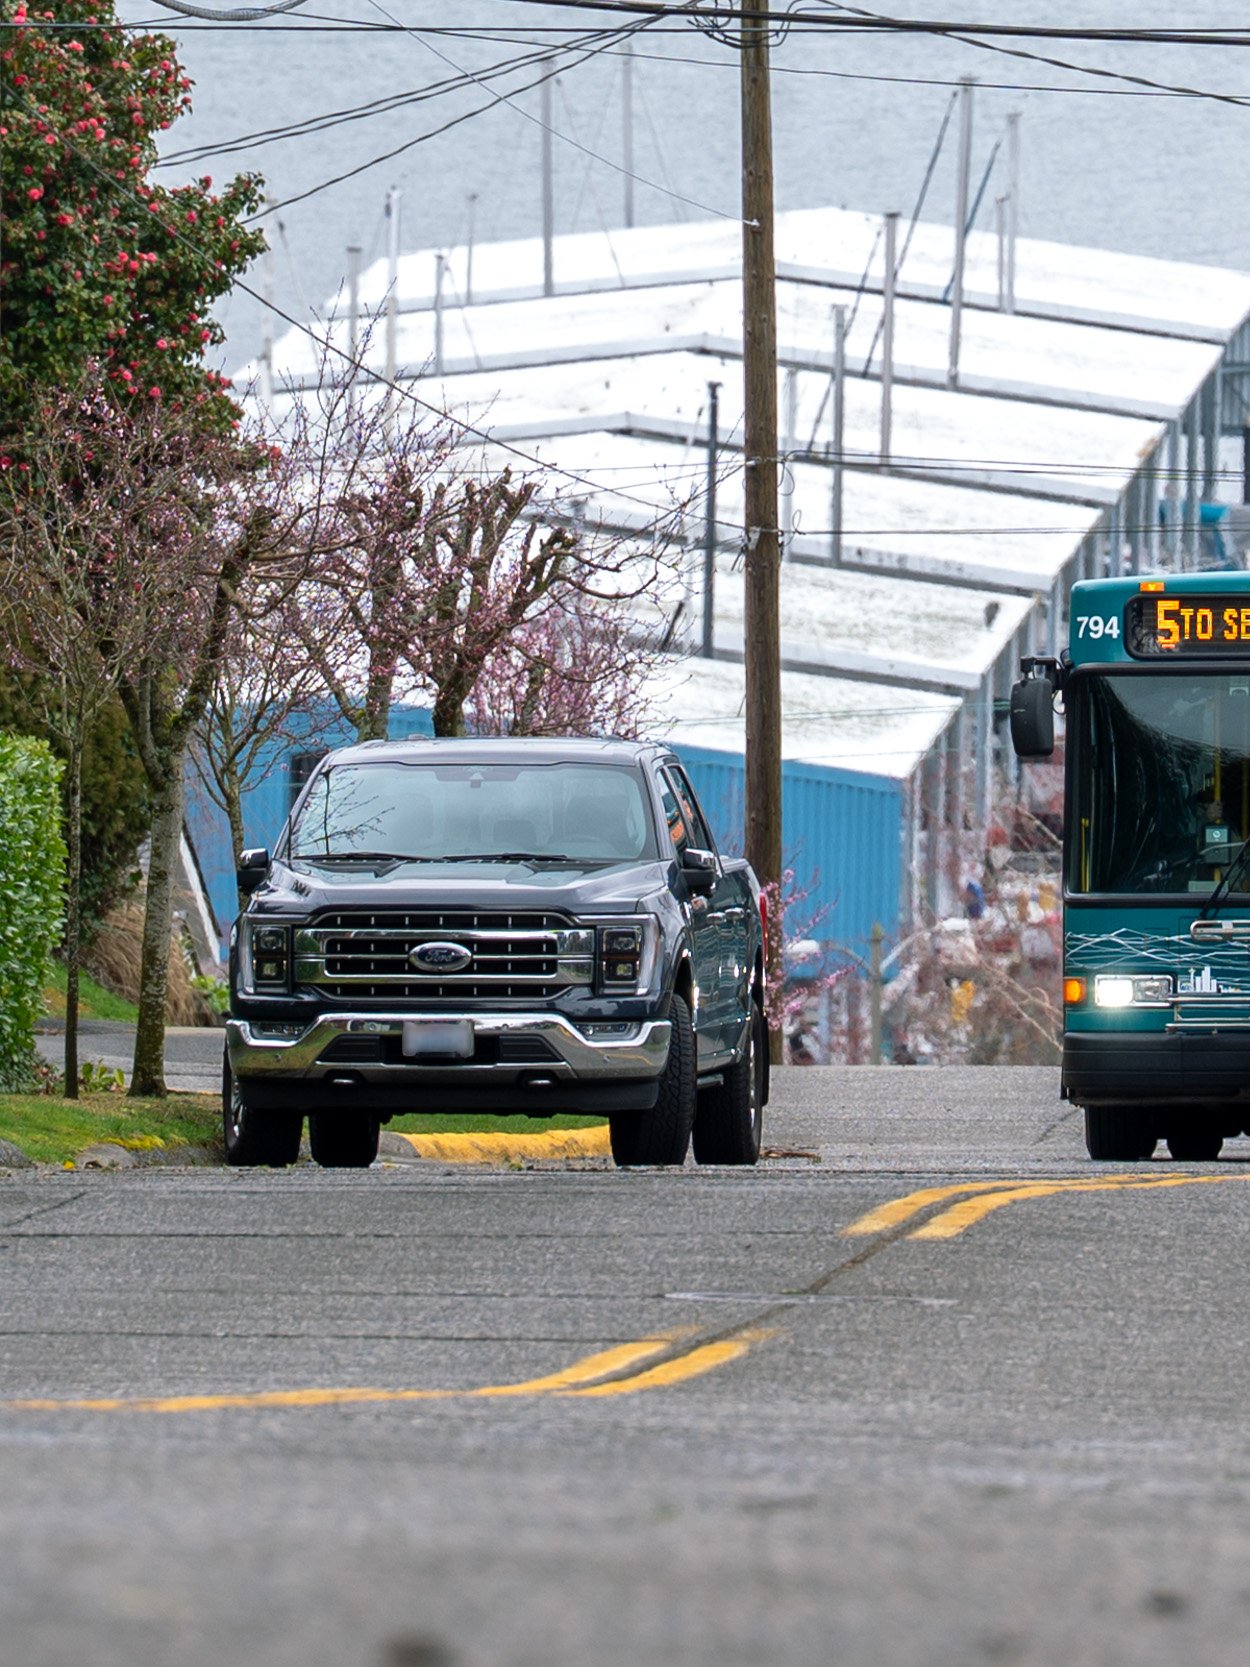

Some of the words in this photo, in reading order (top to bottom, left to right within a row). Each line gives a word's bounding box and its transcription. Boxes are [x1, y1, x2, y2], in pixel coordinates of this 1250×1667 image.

[1076, 616, 1120, 639] 794
[1157, 600, 1180, 649] 5
[1180, 608, 1213, 640] TO
